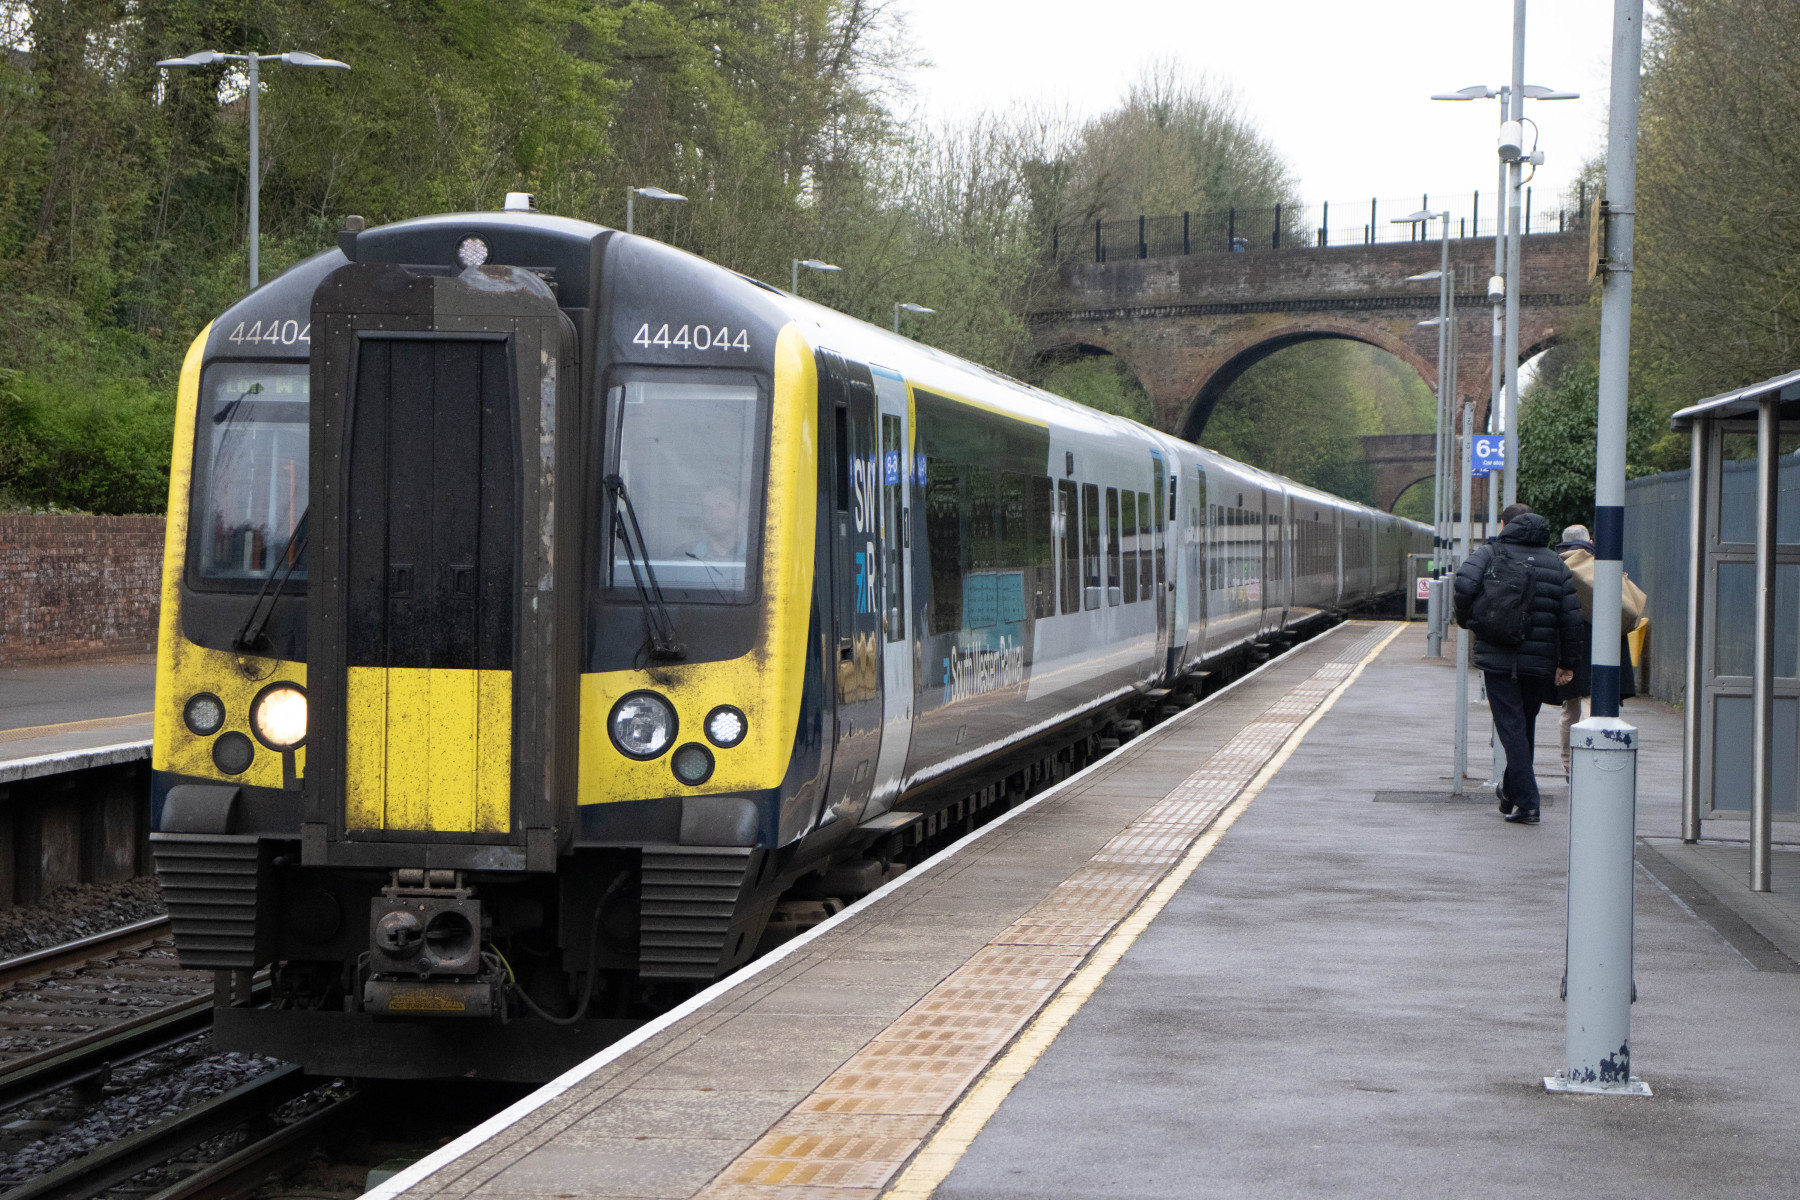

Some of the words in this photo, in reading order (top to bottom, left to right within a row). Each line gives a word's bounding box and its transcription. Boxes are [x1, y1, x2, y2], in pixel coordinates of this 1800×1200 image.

[632, 323, 751, 352] 444044
[855, 458, 876, 533] SW
[866, 541, 877, 613] R
[951, 642, 973, 703] South
[973, 640, 1000, 695] Western
[1000, 634, 1024, 696] Railway
